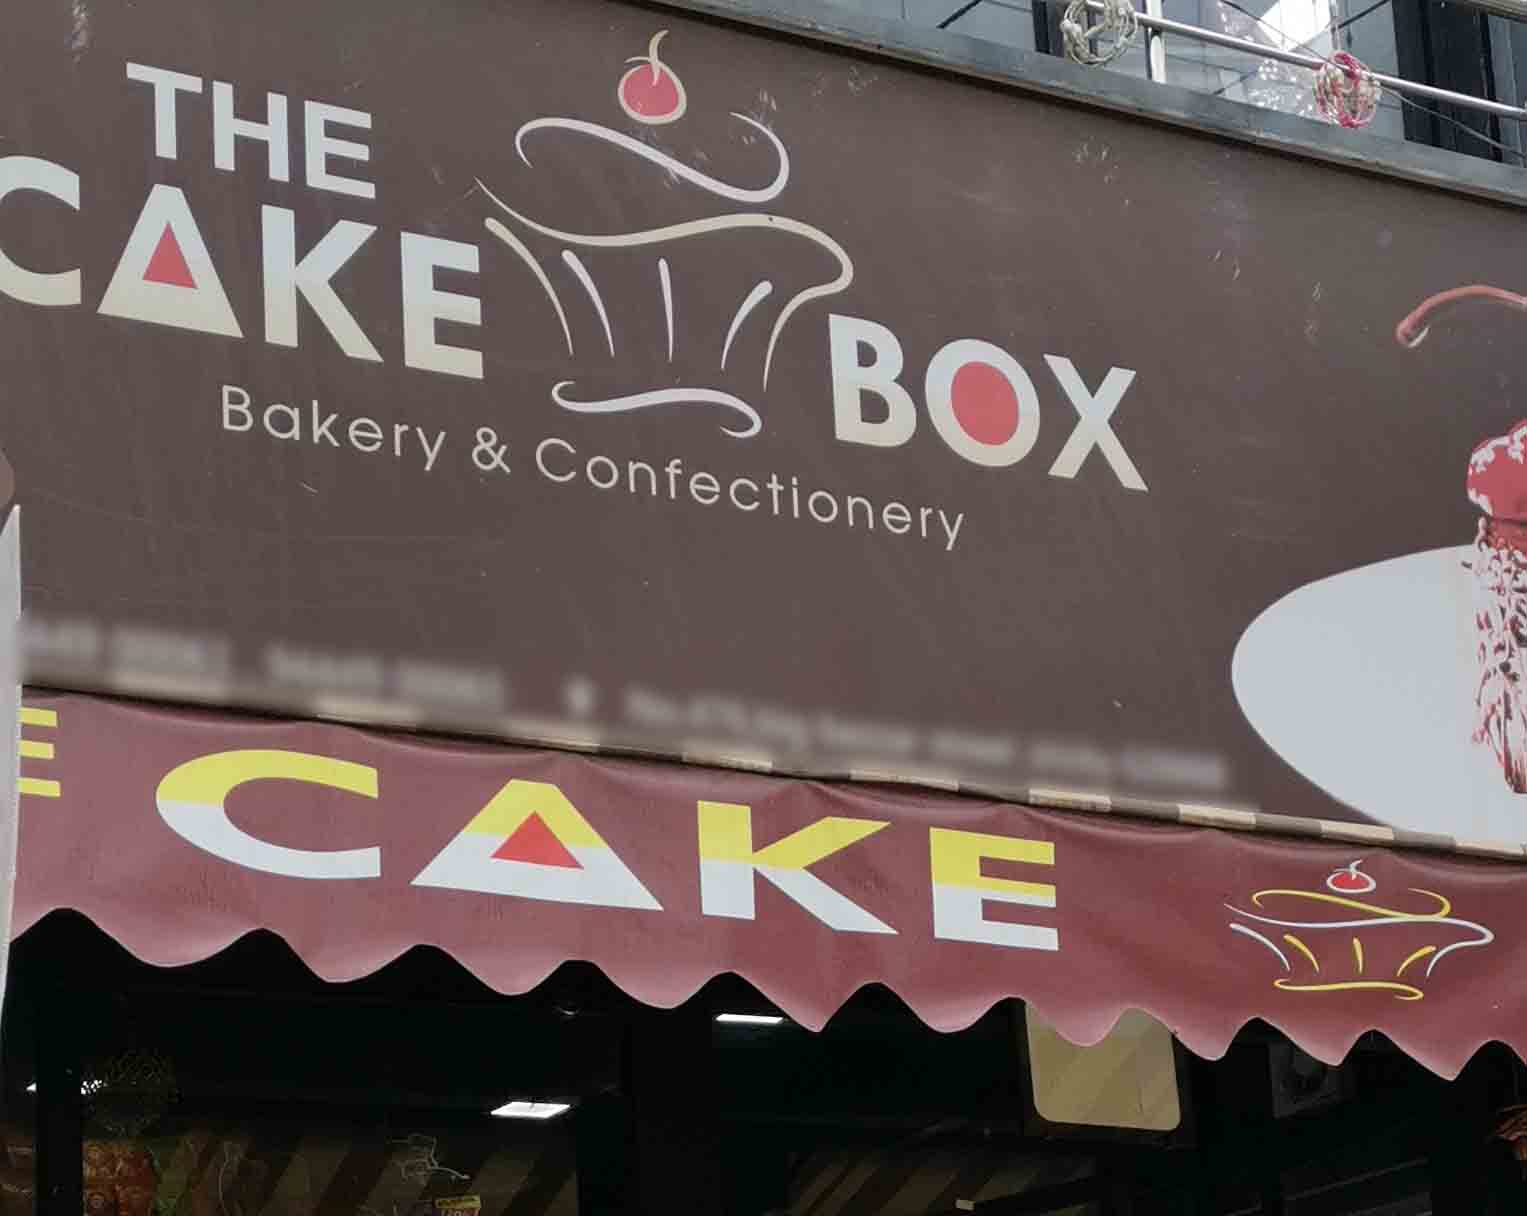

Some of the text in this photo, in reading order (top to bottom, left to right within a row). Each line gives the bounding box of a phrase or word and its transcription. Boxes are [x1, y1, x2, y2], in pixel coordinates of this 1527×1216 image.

[126, 62, 376, 199] THE
[0, 155, 1148, 492] CAKE BOX
[222, 384, 965, 551] Bakery & Confectionery
[156, 748, 1059, 952] CAKE
